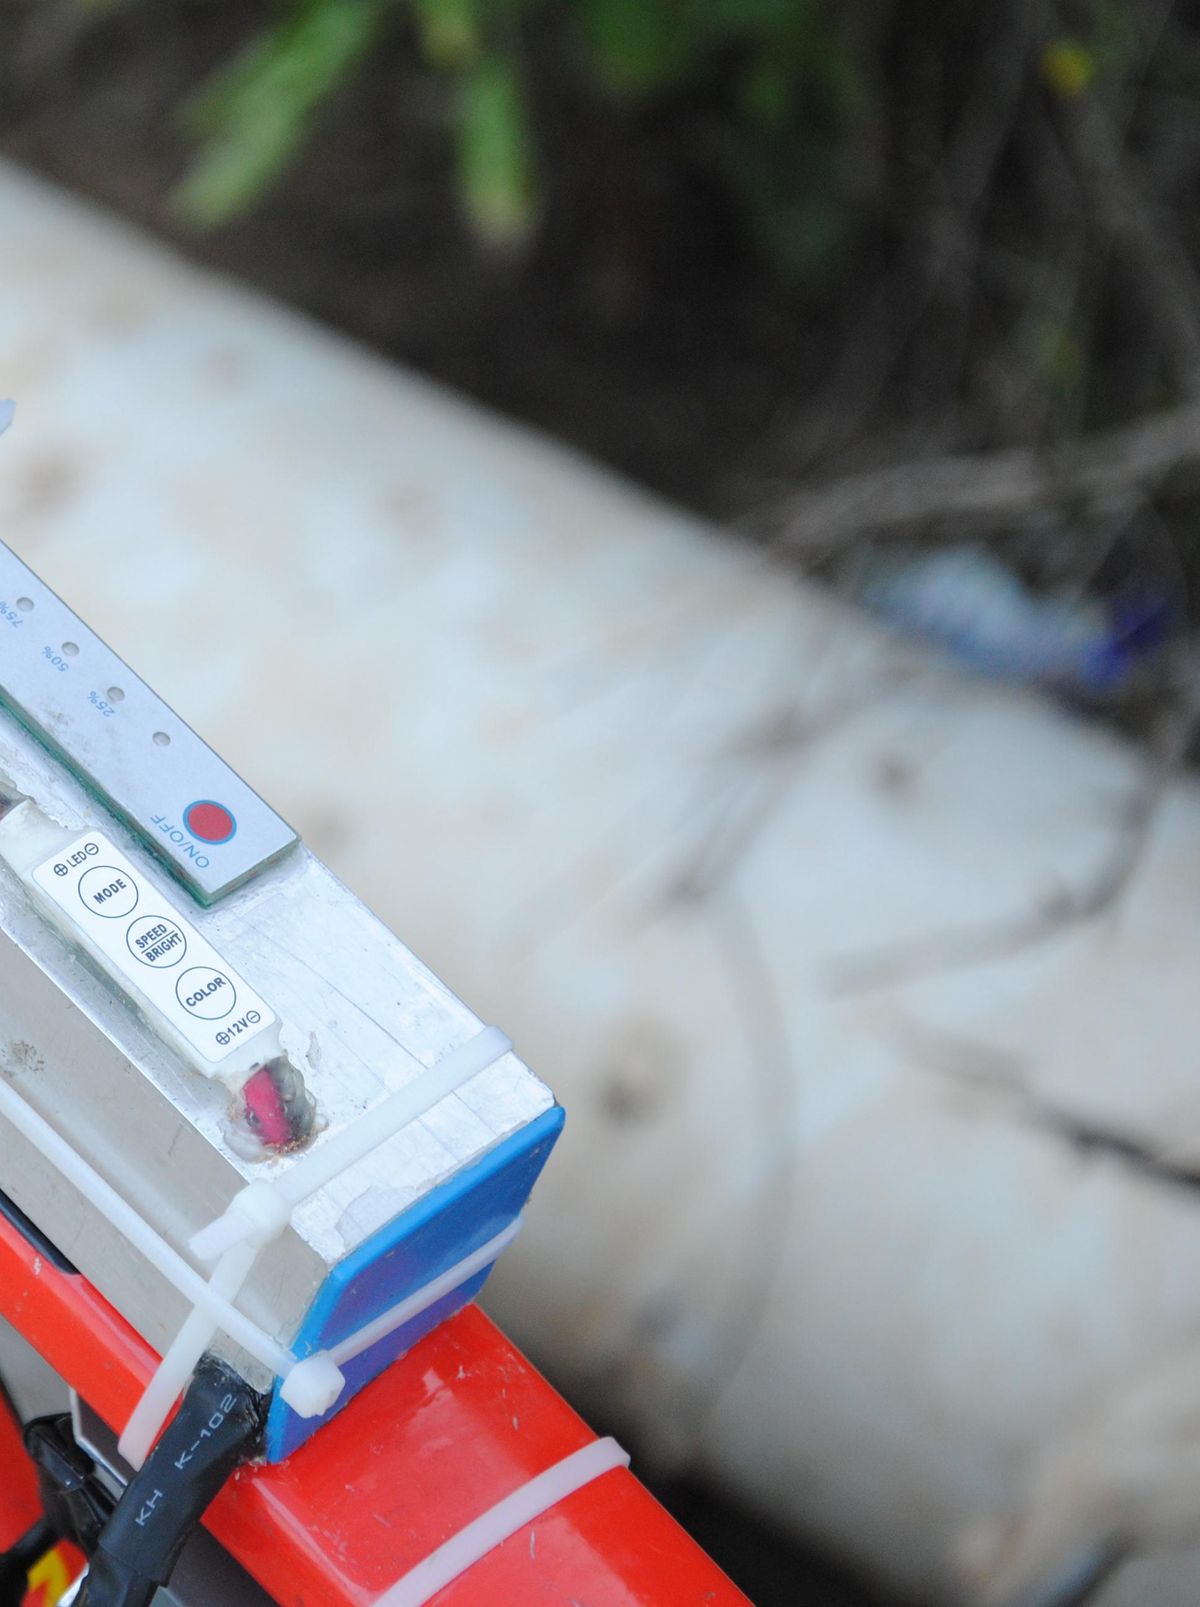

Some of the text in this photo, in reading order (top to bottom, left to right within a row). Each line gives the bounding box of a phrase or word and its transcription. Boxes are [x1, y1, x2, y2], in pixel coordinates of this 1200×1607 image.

[0, 600, 24, 629] 75%
[43, 645, 70, 673] 50%
[88, 689, 117, 718] 25%
[150, 813, 210, 870] ON/OFF
[93, 878, 128, 905] MODE
[135, 923, 168, 949] SPEED
[145, 933, 183, 963] BRIGHT
[185, 976, 227, 1008] COLOR
[135, 1392, 238, 1527] KH K-102
